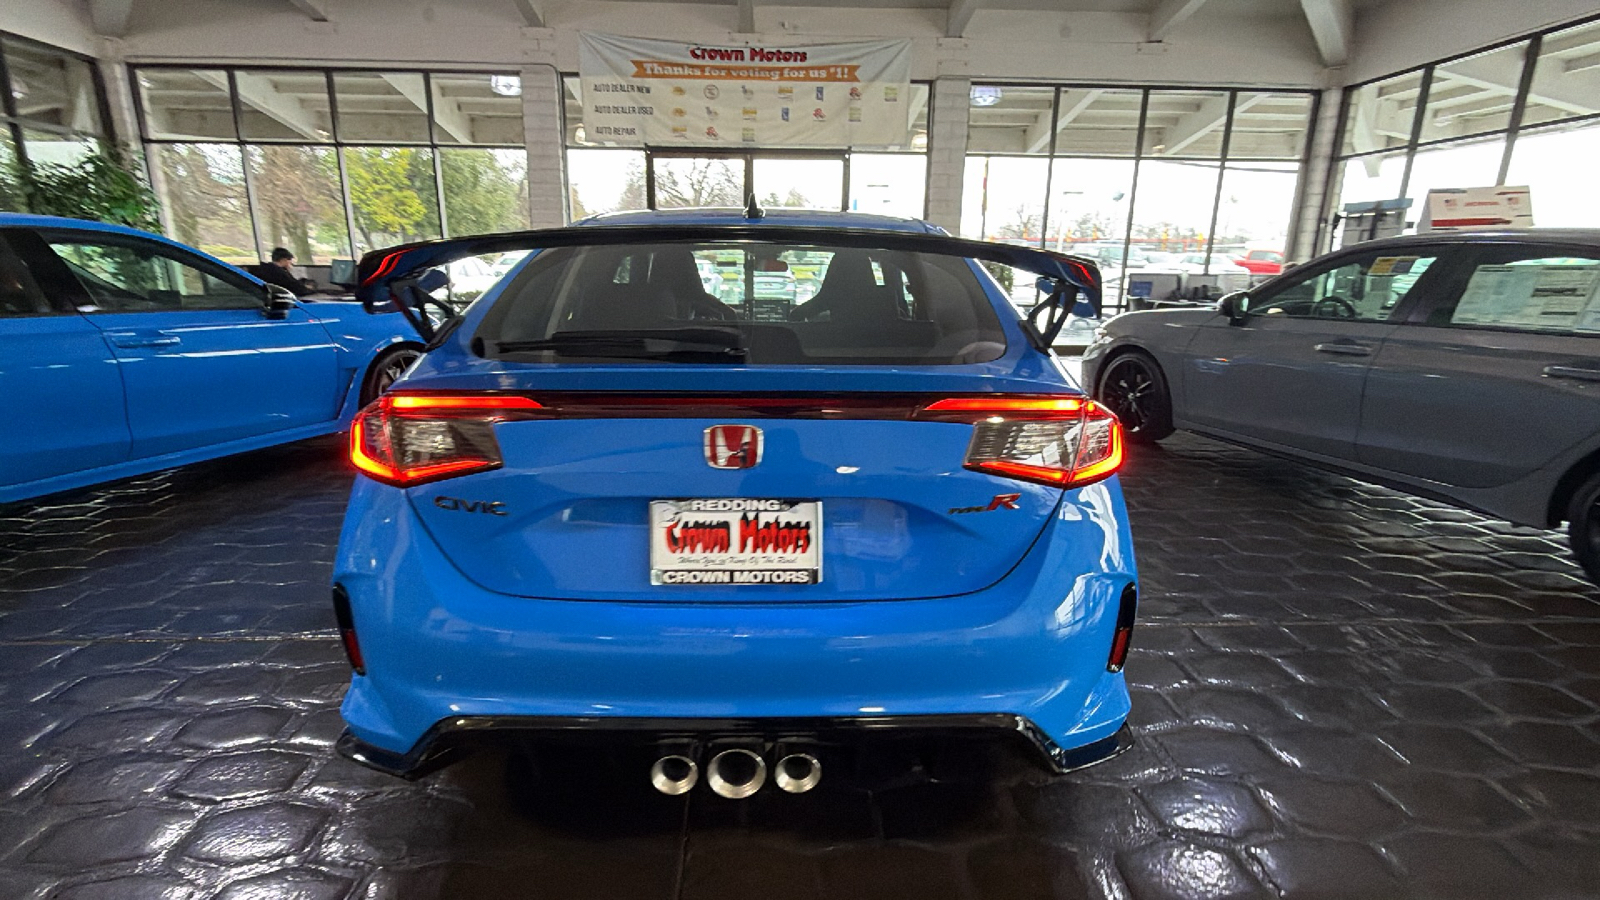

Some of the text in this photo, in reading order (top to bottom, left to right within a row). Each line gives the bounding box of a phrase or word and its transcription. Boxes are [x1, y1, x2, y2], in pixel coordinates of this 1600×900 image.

[690, 47, 807, 62] Crown Motors
[643, 63, 701, 75] Thanks
[704, 67, 727, 76] for
[730, 68, 779, 79] voting
[783, 68, 805, 77] for
[809, 69, 827, 77] us
[593, 83, 610, 92] AUTO
[611, 83, 636, 92] DEALER
[594, 105, 611, 114] AUTO
[611, 105, 637, 115] DEALER
[595, 126, 636, 136] AUTO REPAIR
[434, 496, 507, 515] CIVIC
[692, 499, 781, 511] REDDING
[987, 493, 1021, 511] R
[665, 512, 811, 554] Crown Motors
[663, 570, 809, 583] CROWN MOTORS
